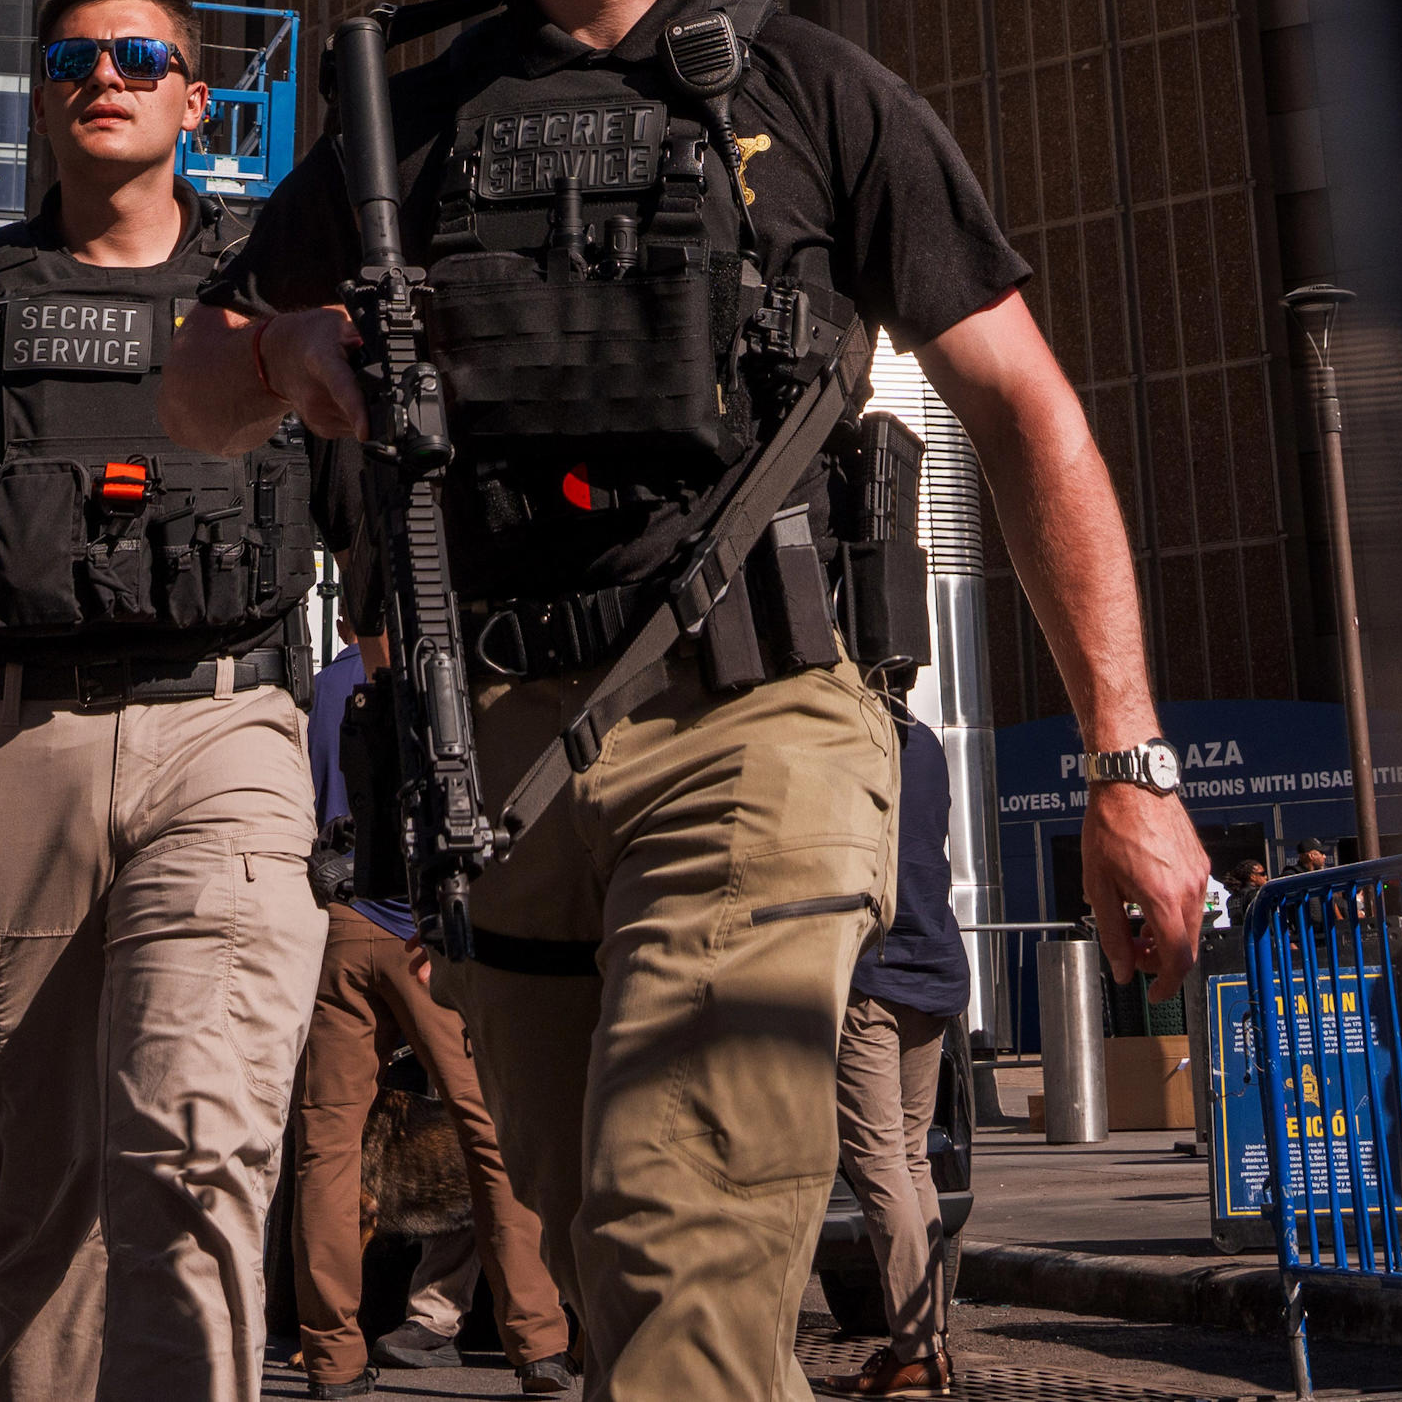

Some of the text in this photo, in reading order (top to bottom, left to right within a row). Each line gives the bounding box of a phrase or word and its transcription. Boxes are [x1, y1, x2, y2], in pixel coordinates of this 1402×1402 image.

[683, 19, 718, 30] MOTOROLA
[491, 106, 655, 153] SECRET
[488, 145, 652, 195] SERVICE
[21, 304, 138, 333] SECRET
[13, 338, 141, 367] SERVICE
[1181, 740, 1244, 769] AZA
[1000, 792, 1066, 812] LOYEES,
[1178, 778, 1245, 799] ATRONS
[1250, 774, 1296, 793] WITH
